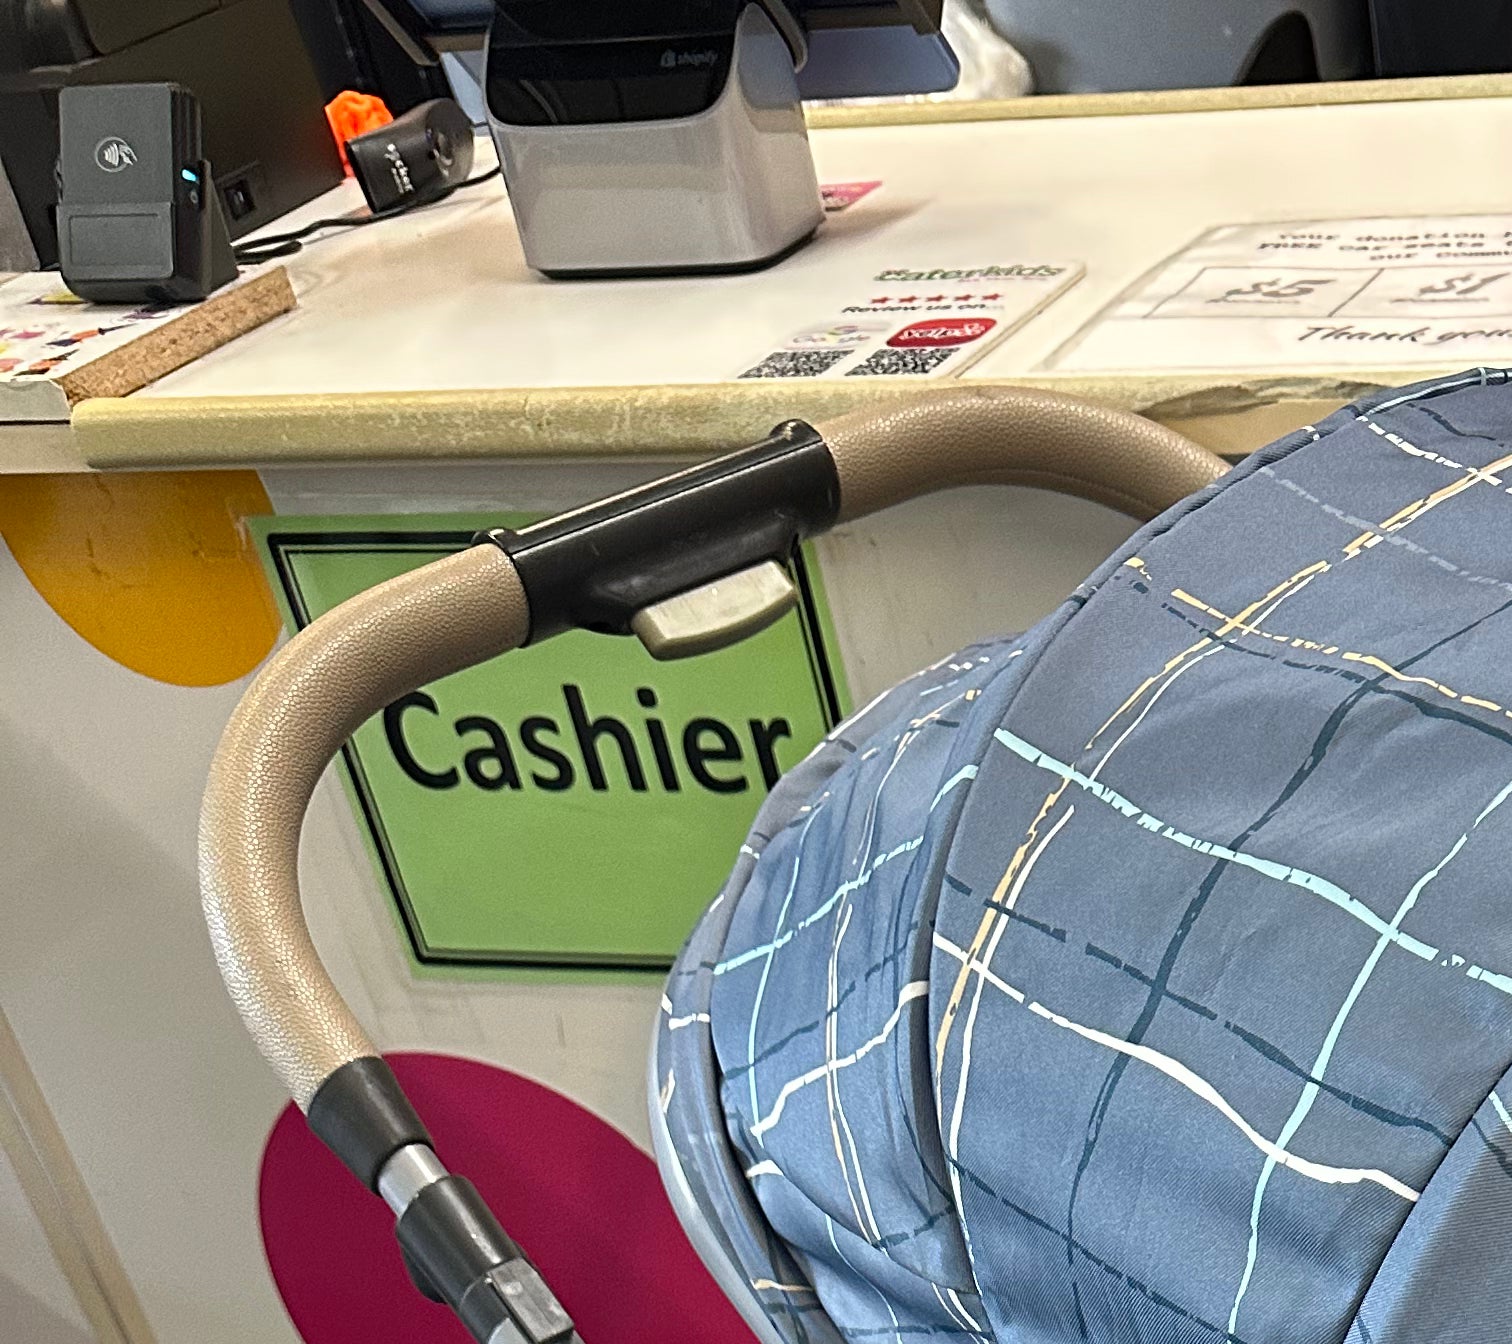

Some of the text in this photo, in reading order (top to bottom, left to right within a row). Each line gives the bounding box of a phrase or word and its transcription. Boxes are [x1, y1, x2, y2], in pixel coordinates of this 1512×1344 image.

[842, 305, 922, 314] Review
[926, 304, 953, 312] us
[1297, 325, 1431, 343] Thank
[381, 682, 793, 795] Cashier
